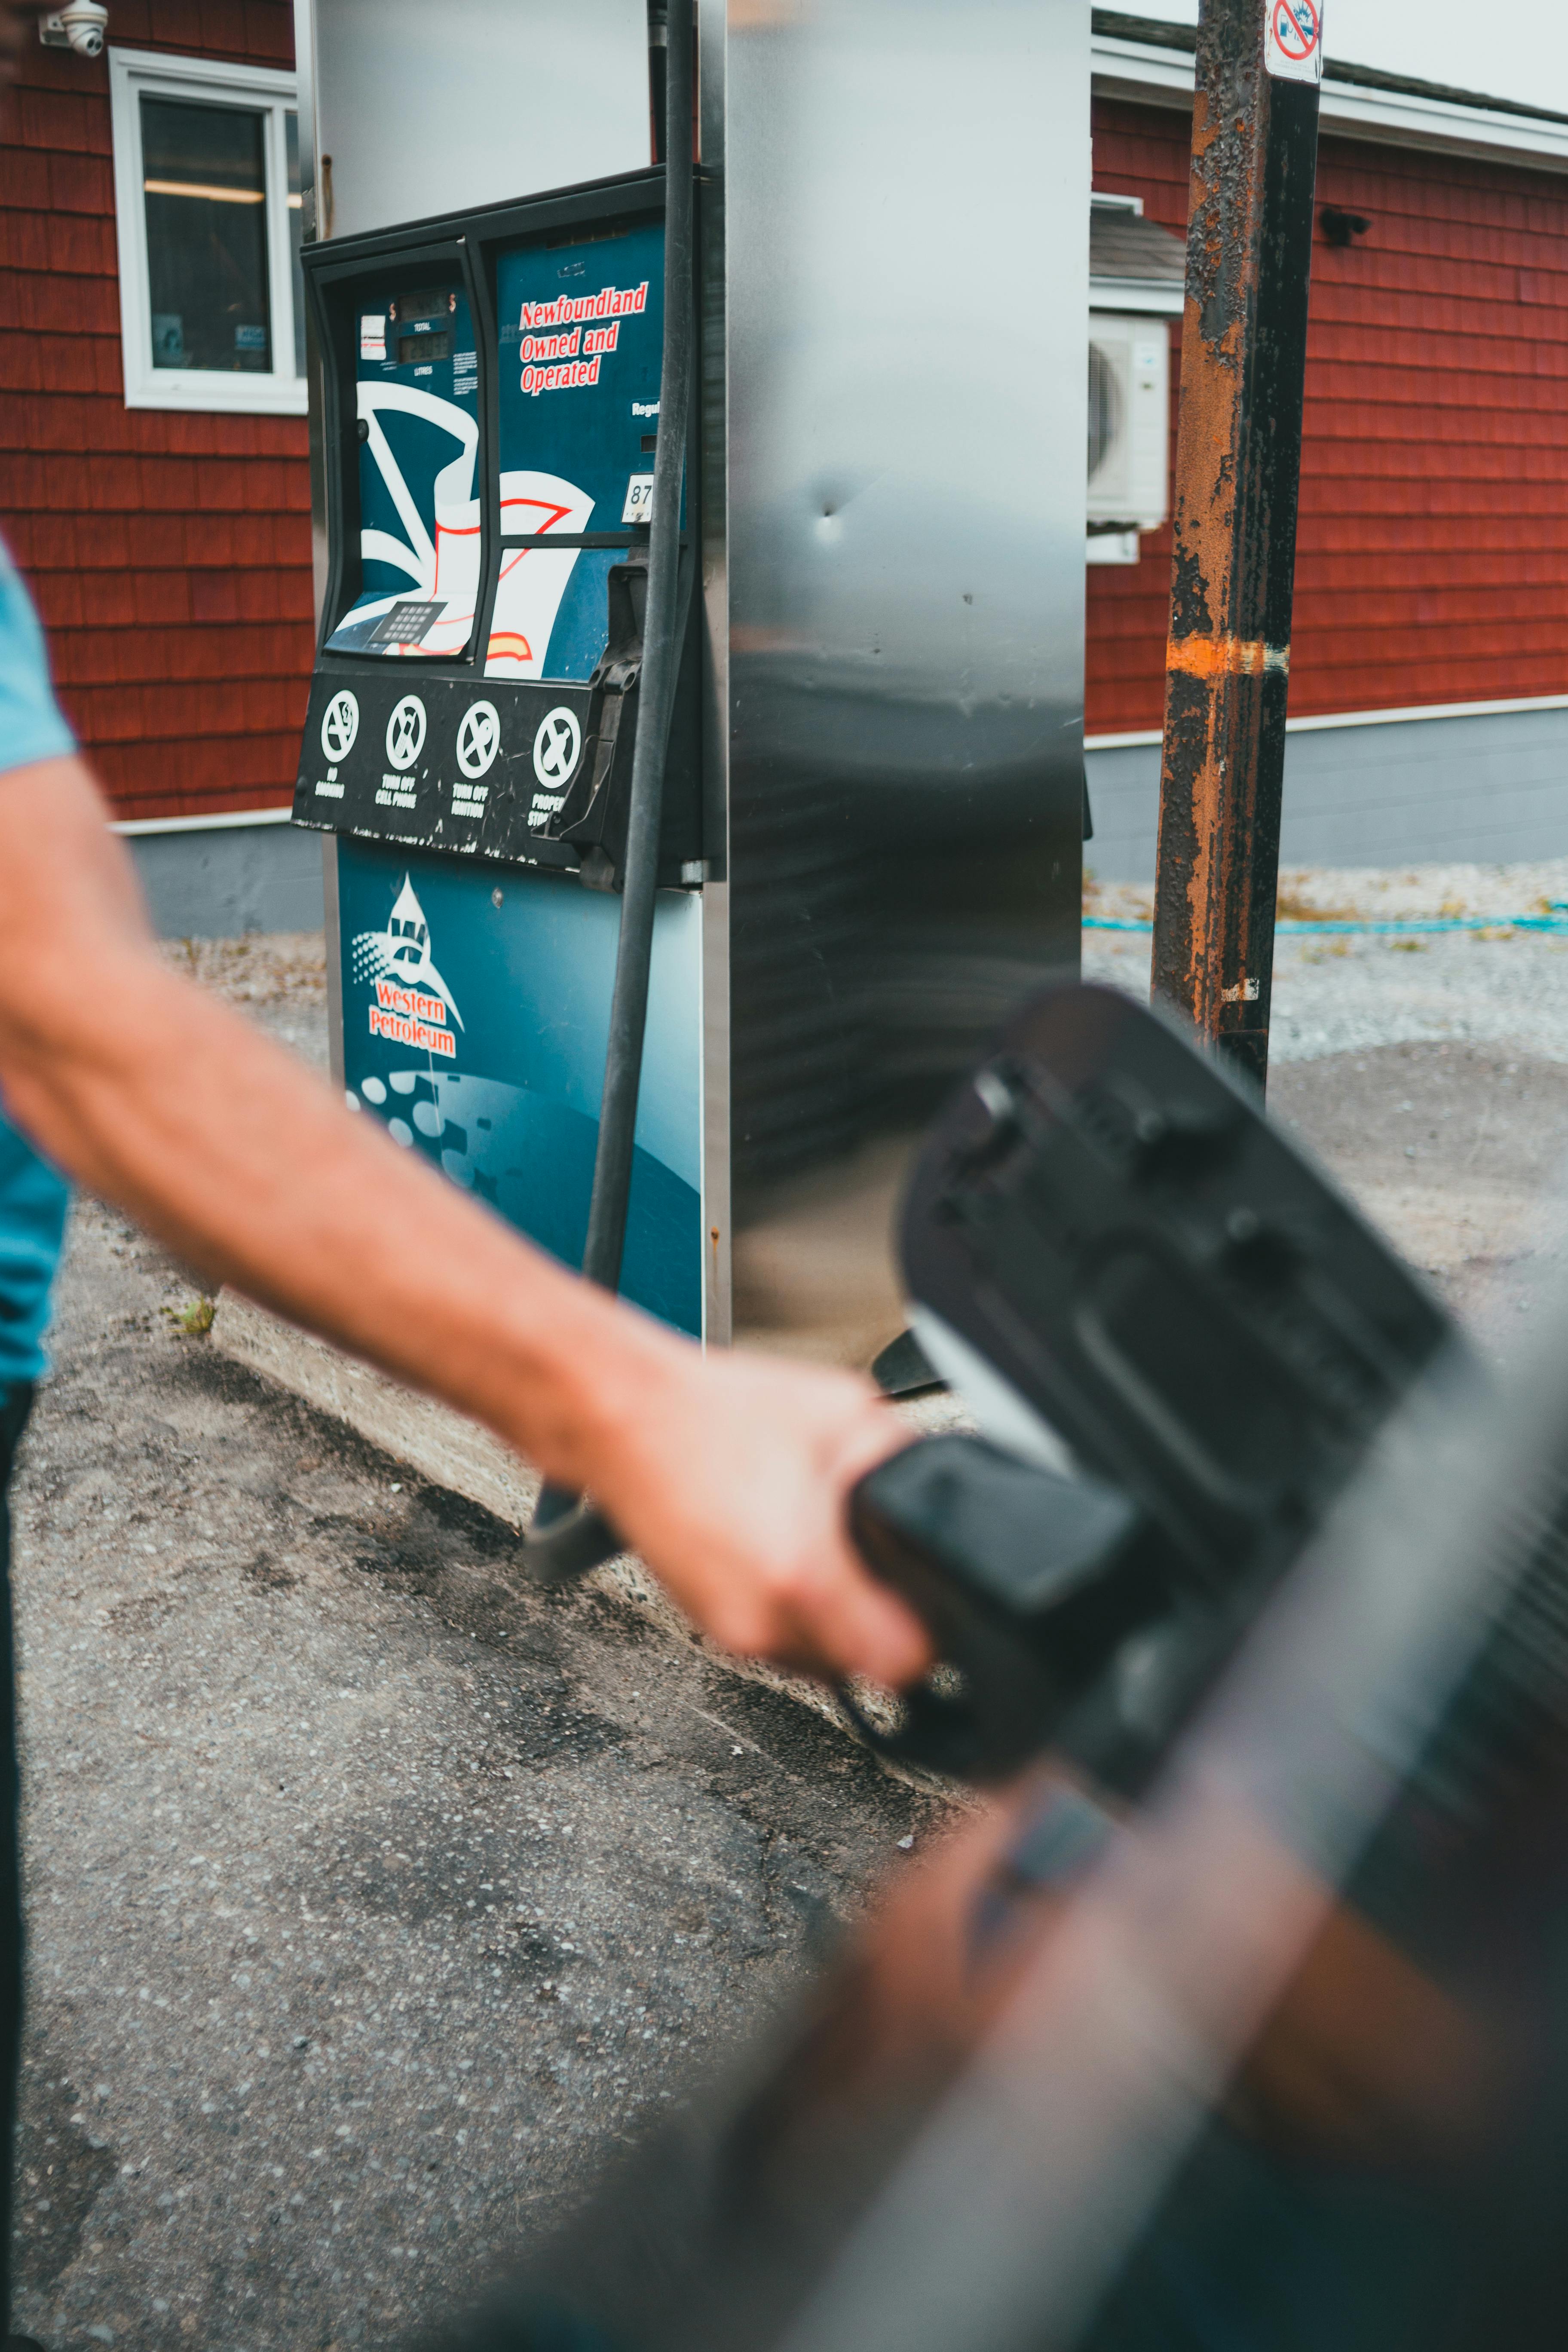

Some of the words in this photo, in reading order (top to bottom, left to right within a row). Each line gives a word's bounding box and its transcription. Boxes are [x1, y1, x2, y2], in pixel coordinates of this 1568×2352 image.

[519, 282, 649, 330] Newfoundland
[414, 322, 431, 332] TOTAL
[520, 326, 582, 363] Owned
[583, 321, 620, 355] and
[414, 366, 433, 376] LITRES
[521, 355, 601, 396] Operated
[632, 401, 660, 417] Regul
[631, 485, 652, 504] 87
[327, 767, 338, 782] NO
[382, 774, 401, 790] TURN
[401, 776, 416, 792] OFF
[315, 781, 345, 799] SMOKING
[375, 789, 392, 805] CELL
[392, 791, 417, 809] PHONE
[453, 782, 473, 799] TURN
[473, 785, 489, 802] OFF
[451, 799, 484, 818] IGNITION
[376, 978, 446, 1024] Western
[370, 1007, 455, 1057] Petroleum
